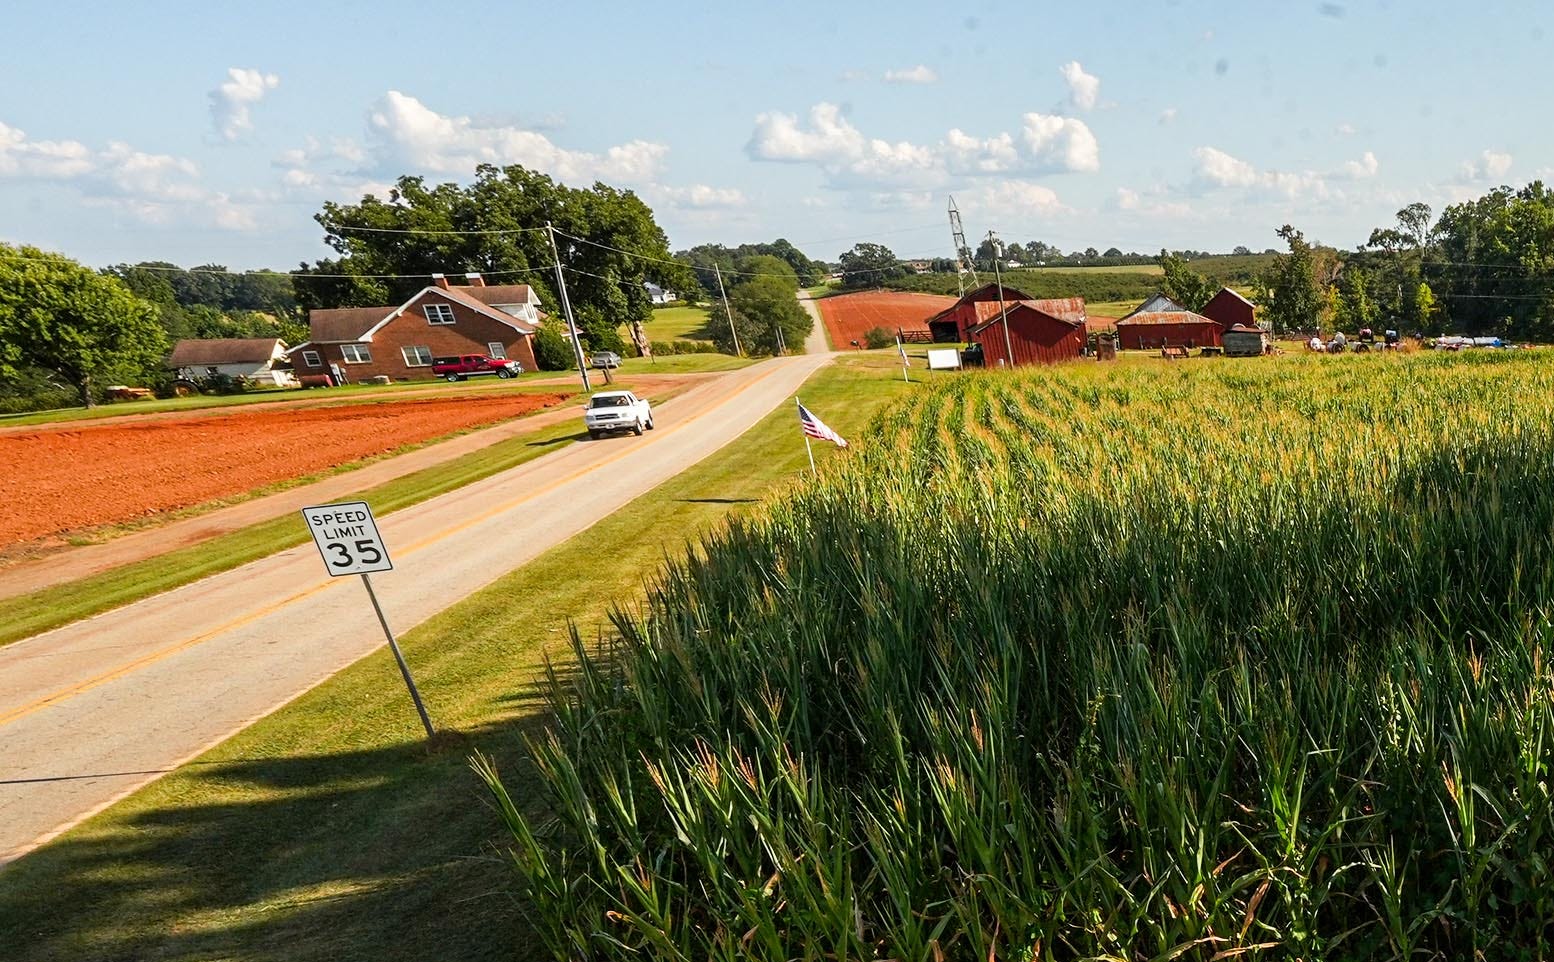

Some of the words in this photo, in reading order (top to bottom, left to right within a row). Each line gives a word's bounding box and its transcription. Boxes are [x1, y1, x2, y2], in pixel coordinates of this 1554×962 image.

[312, 510, 367, 526] SPEED
[323, 525, 365, 540] LIMIT
[326, 539, 382, 568] 35
